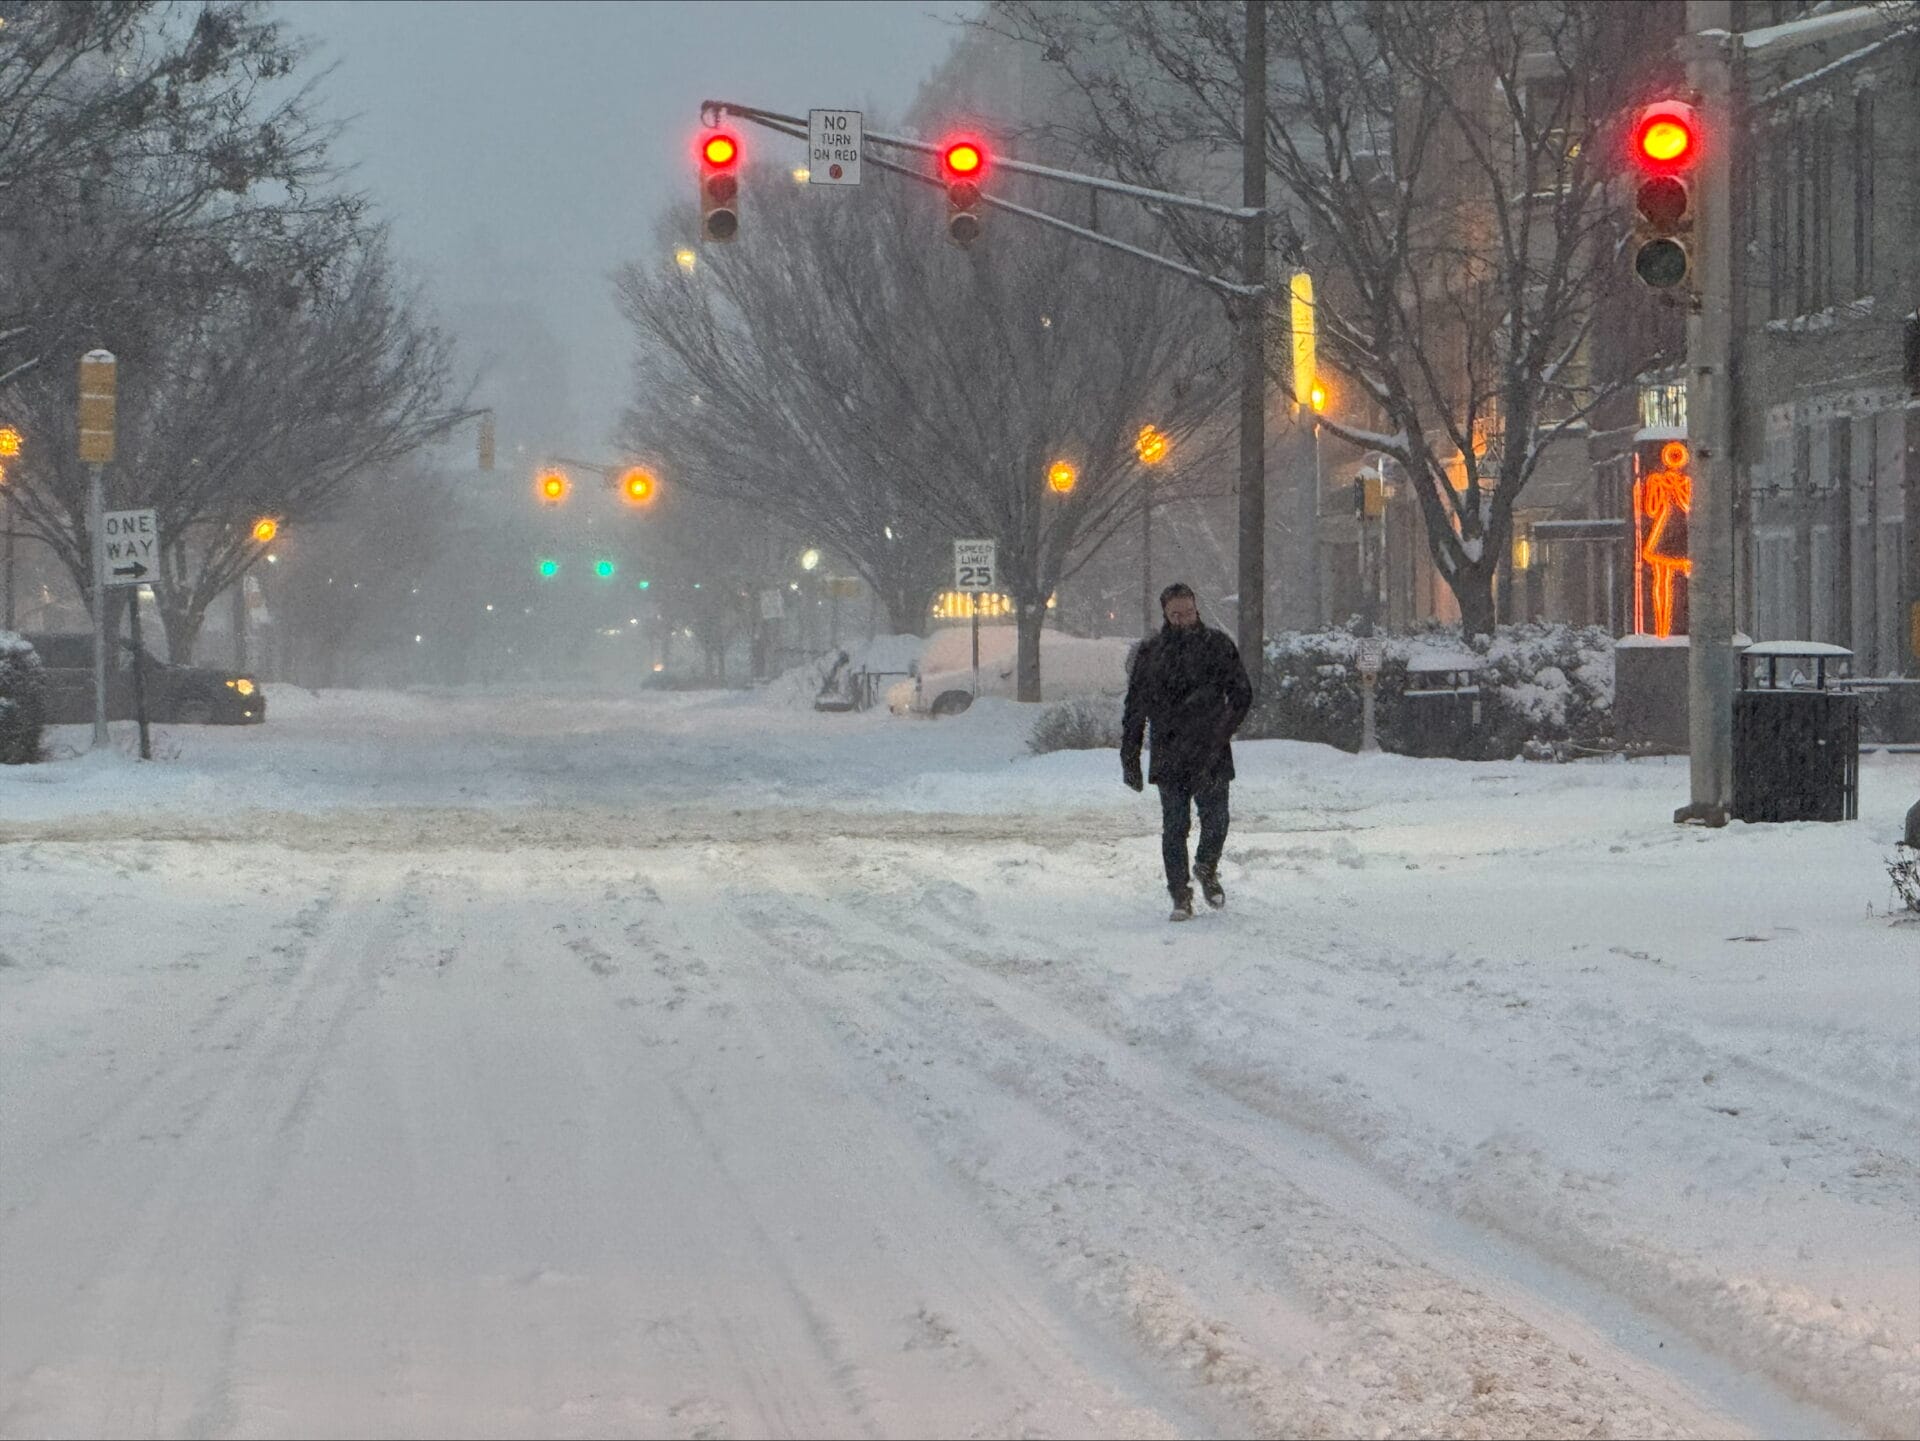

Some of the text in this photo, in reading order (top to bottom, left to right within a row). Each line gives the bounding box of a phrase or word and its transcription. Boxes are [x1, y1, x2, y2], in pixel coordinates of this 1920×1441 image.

[824, 115, 847, 131] NO
[823, 133, 851, 146] TURN
[814, 148, 857, 162] ON RED
[107, 516, 150, 535] ONE
[106, 540, 153, 560] WAY
[961, 554, 989, 565] LIMIT
[959, 566, 992, 586] 25
